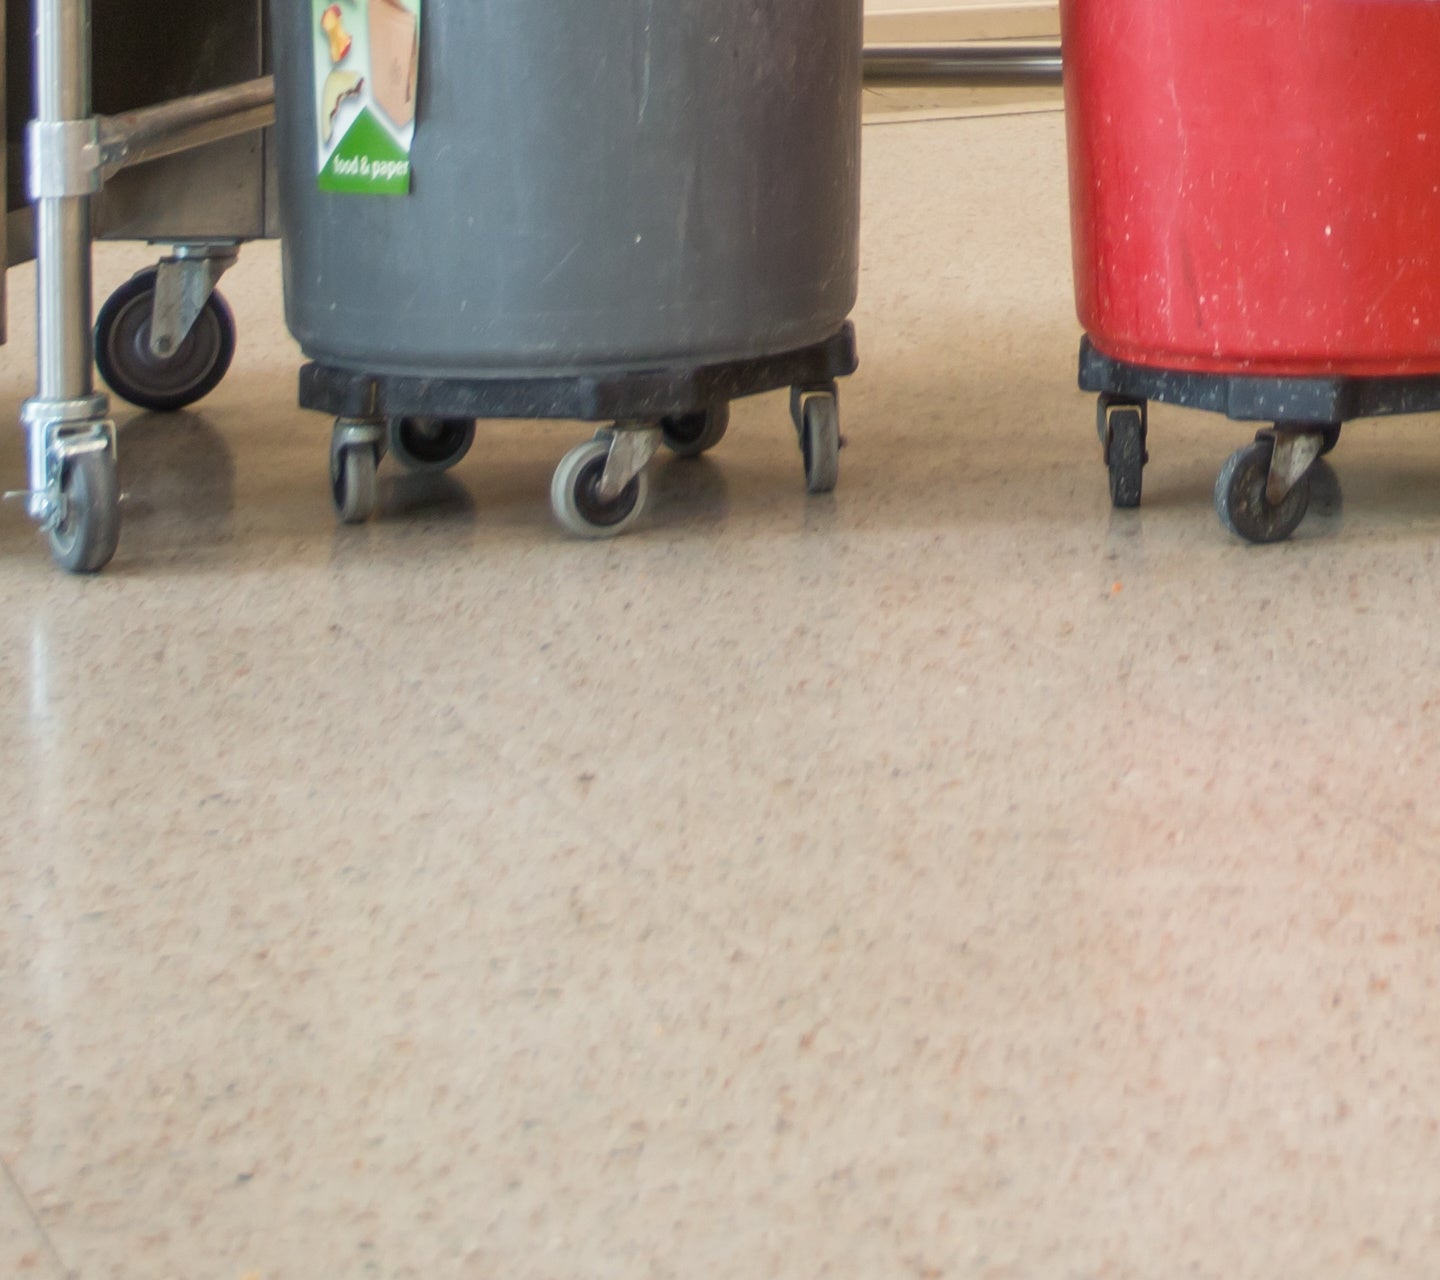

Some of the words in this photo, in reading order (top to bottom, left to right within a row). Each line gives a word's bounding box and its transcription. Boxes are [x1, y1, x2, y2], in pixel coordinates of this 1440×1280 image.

[333, 153, 359, 174] food
[360, 154, 370, 174] &
[371, 160, 409, 181] paper
